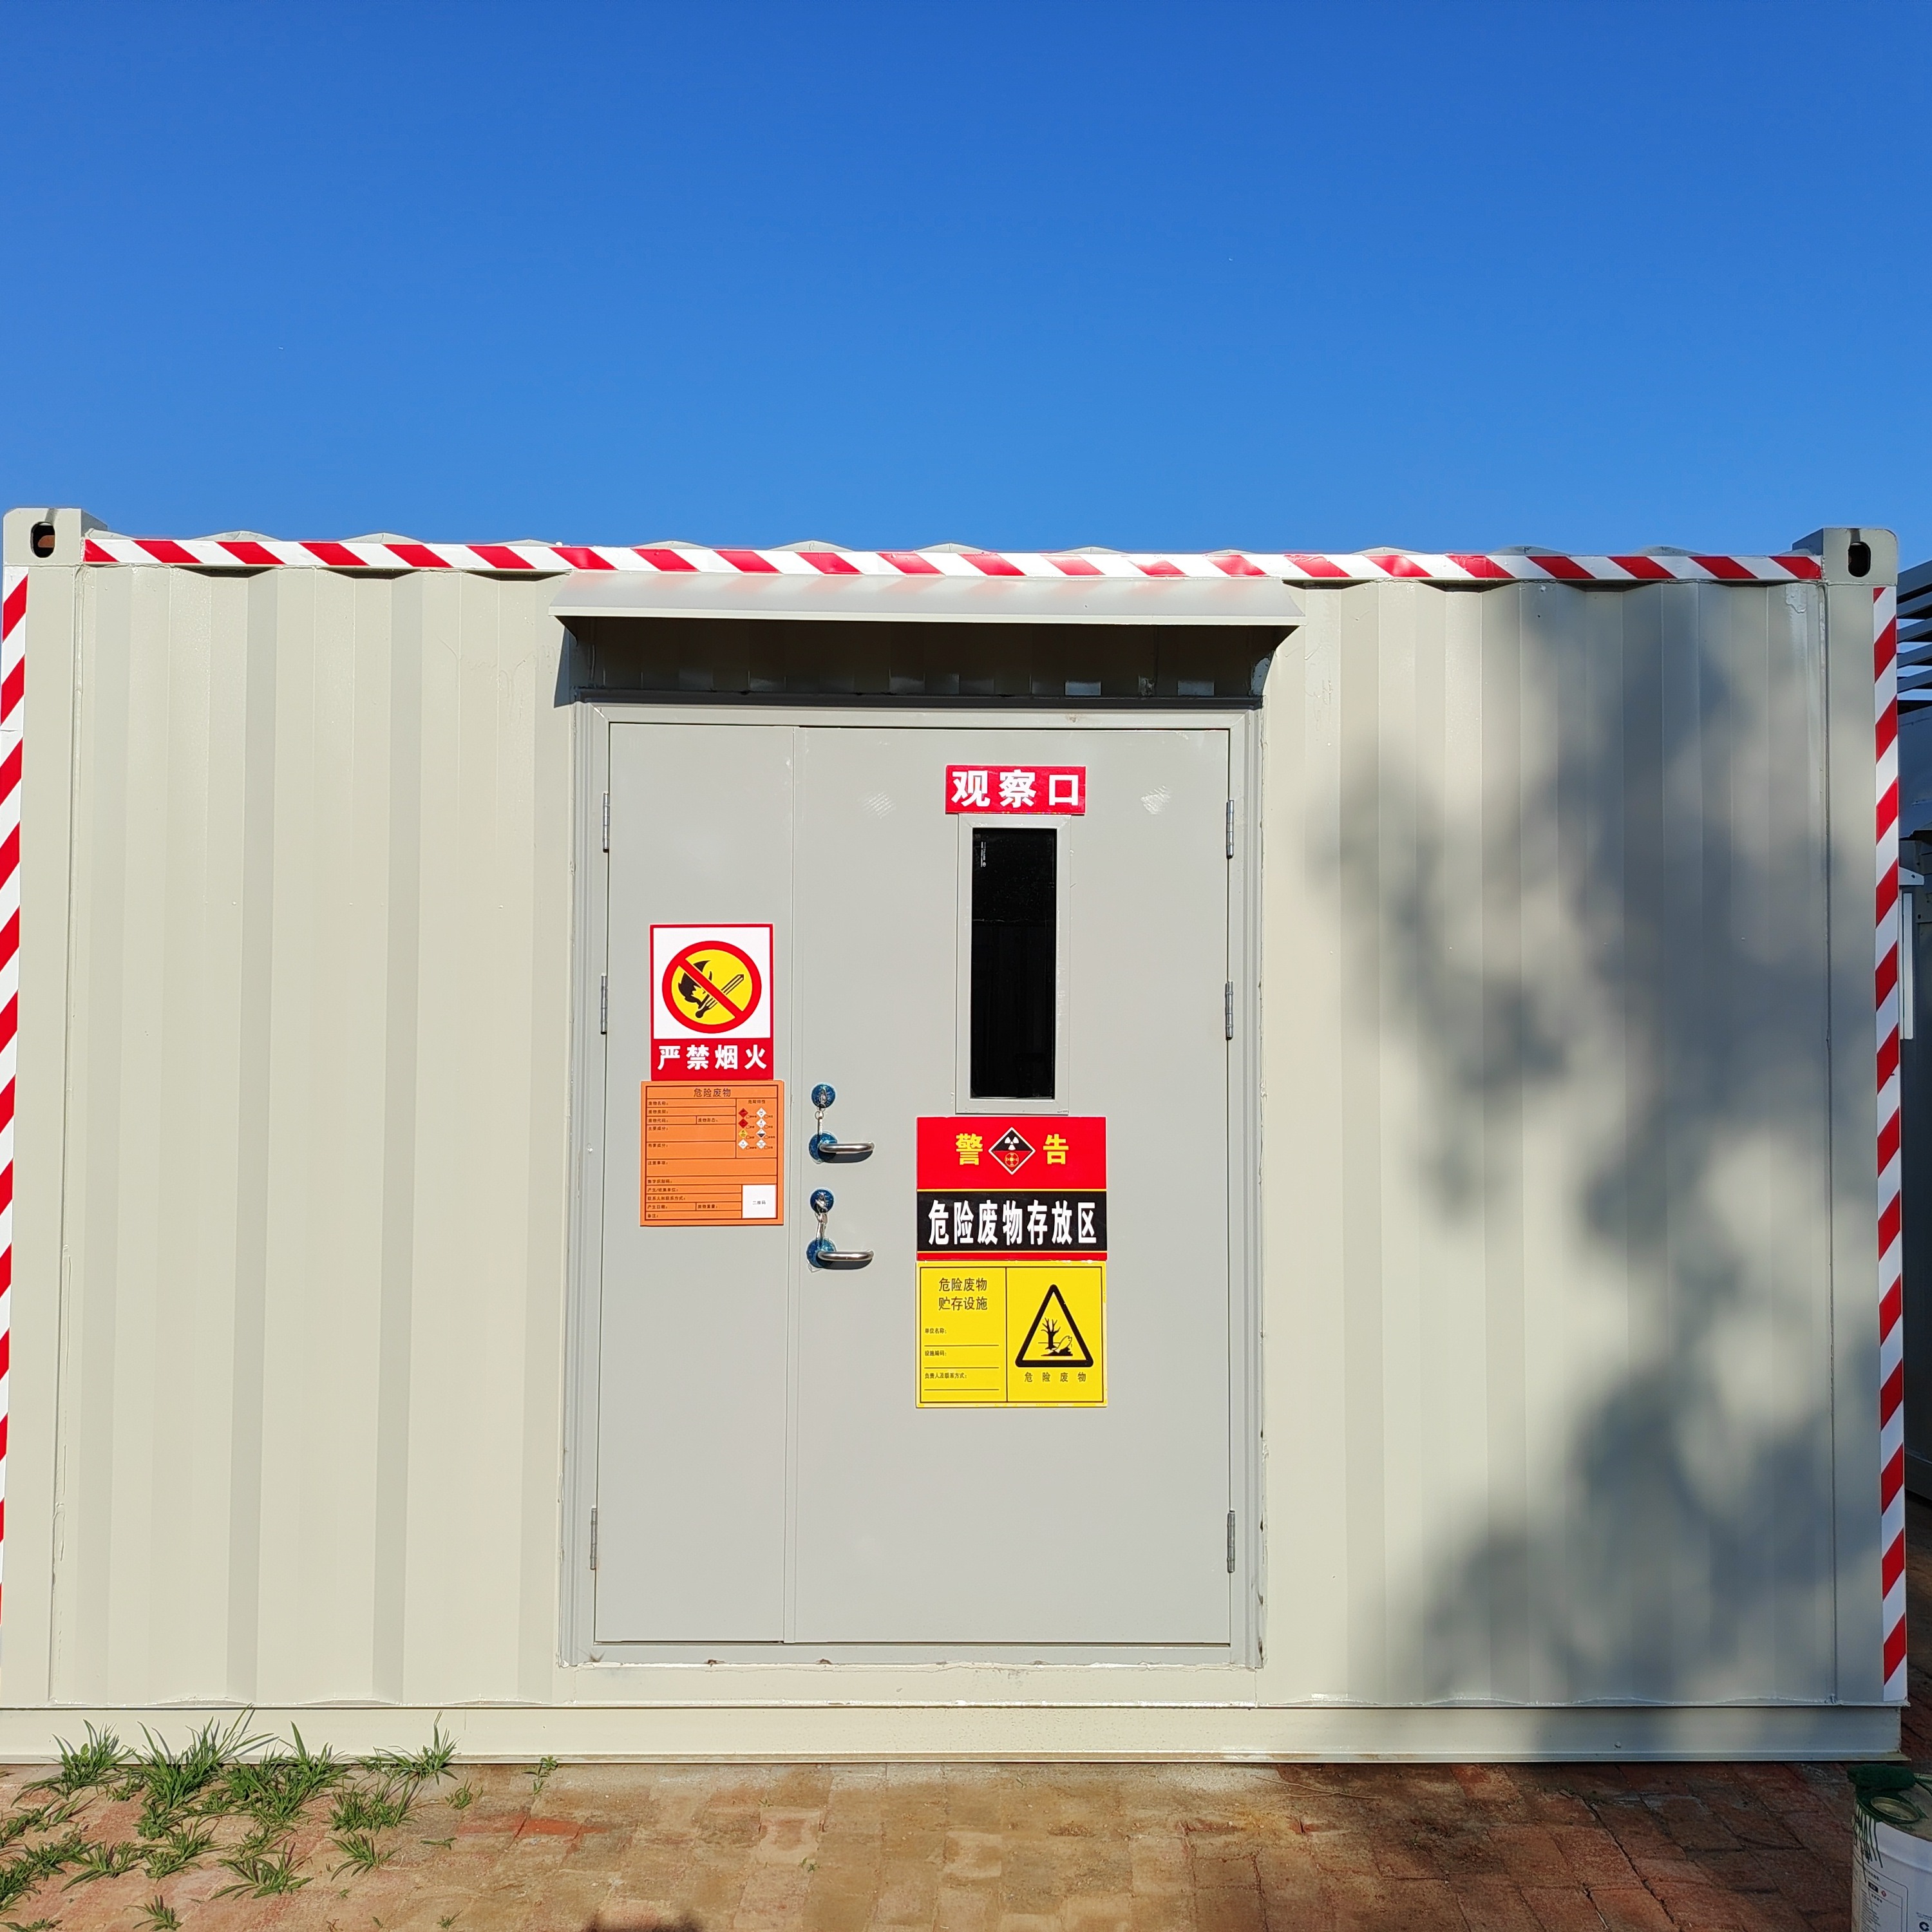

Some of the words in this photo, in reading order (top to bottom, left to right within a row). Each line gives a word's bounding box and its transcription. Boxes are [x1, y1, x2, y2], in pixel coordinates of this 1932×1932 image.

[951, 768, 1081, 810] 观察口
[658, 1045, 768, 1070] 严禁烟火
[694, 1088, 732, 1097] 危险废物
[956, 1133, 983, 1166] 警
[1042, 1133, 1070, 1166] 告
[927, 1197, 1098, 1245] 危险废物存放区
[938, 1277, 987, 1292] 危险废物
[938, 1296, 988, 1311] 贮存设施
[1024, 1371, 1086, 1382] 危险废物
